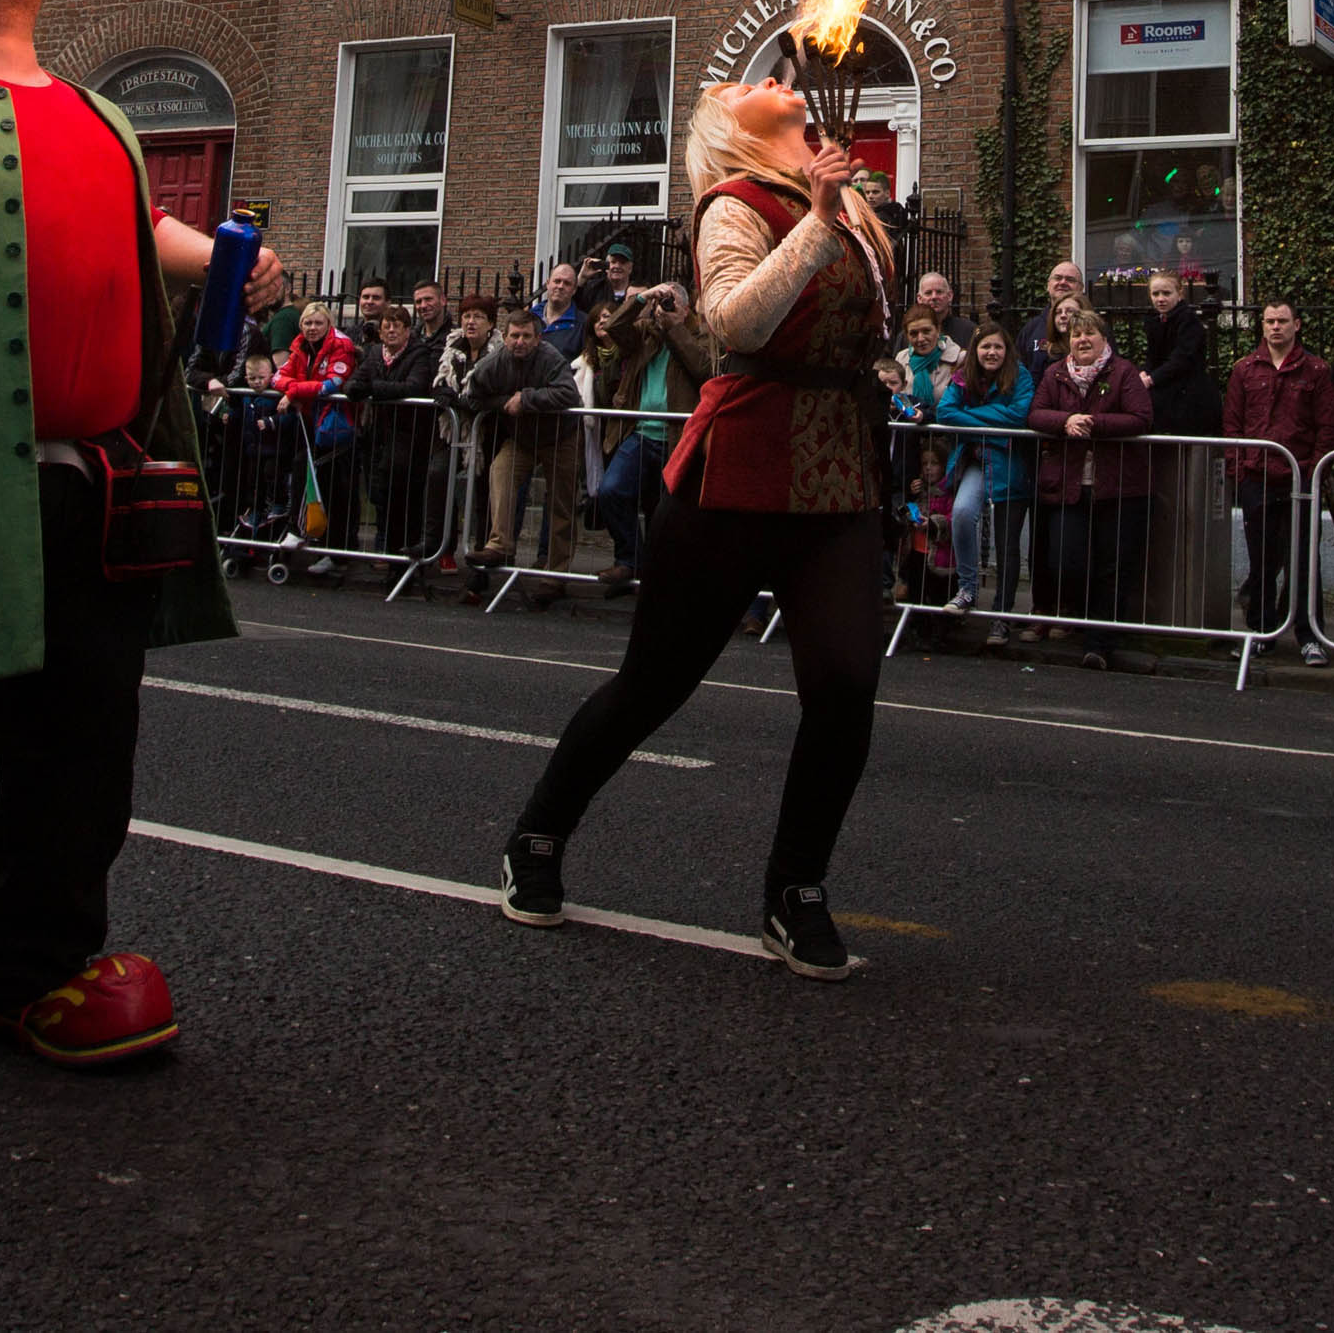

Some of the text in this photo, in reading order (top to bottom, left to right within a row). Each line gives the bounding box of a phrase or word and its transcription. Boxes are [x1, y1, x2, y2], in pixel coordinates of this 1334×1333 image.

[1144, 24, 1201, 38] Rooney
[127, 70, 193, 87] PROTESTANT
[158, 101, 204, 114] ASSOCIATION
[610, 121, 642, 137] GLYNN
[643, 121, 651, 136] &
[394, 131, 423, 147] GLYNN
[424, 132, 432, 146] &
[590, 142, 642, 156] SOLICITORS
[377, 152, 423, 165] SOLICITORS
